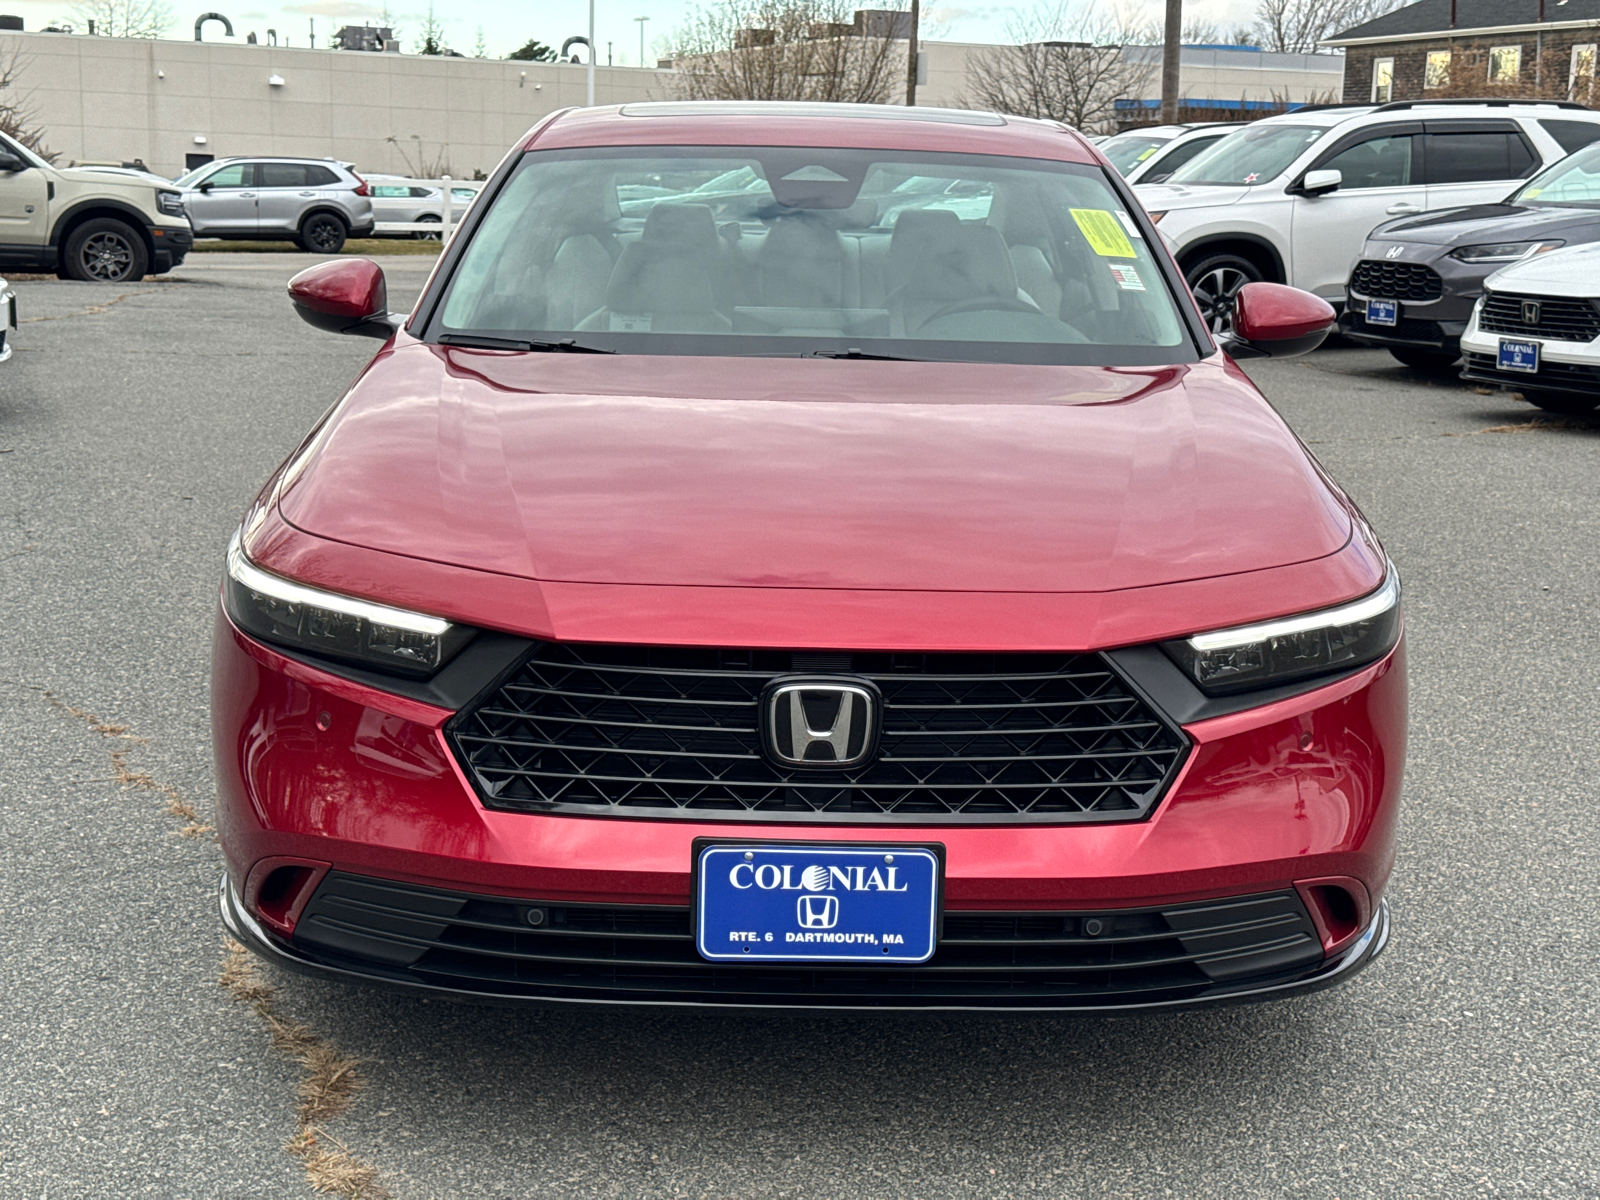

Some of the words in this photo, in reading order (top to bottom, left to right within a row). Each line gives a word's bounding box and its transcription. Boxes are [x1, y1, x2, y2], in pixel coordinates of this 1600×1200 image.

[729, 863, 908, 892] COLONIAL
[729, 931, 761, 942] RTE.
[764, 932, 774, 942] 6
[785, 932, 879, 945] DARTMOUTH,
[882, 934, 904, 944] MA
